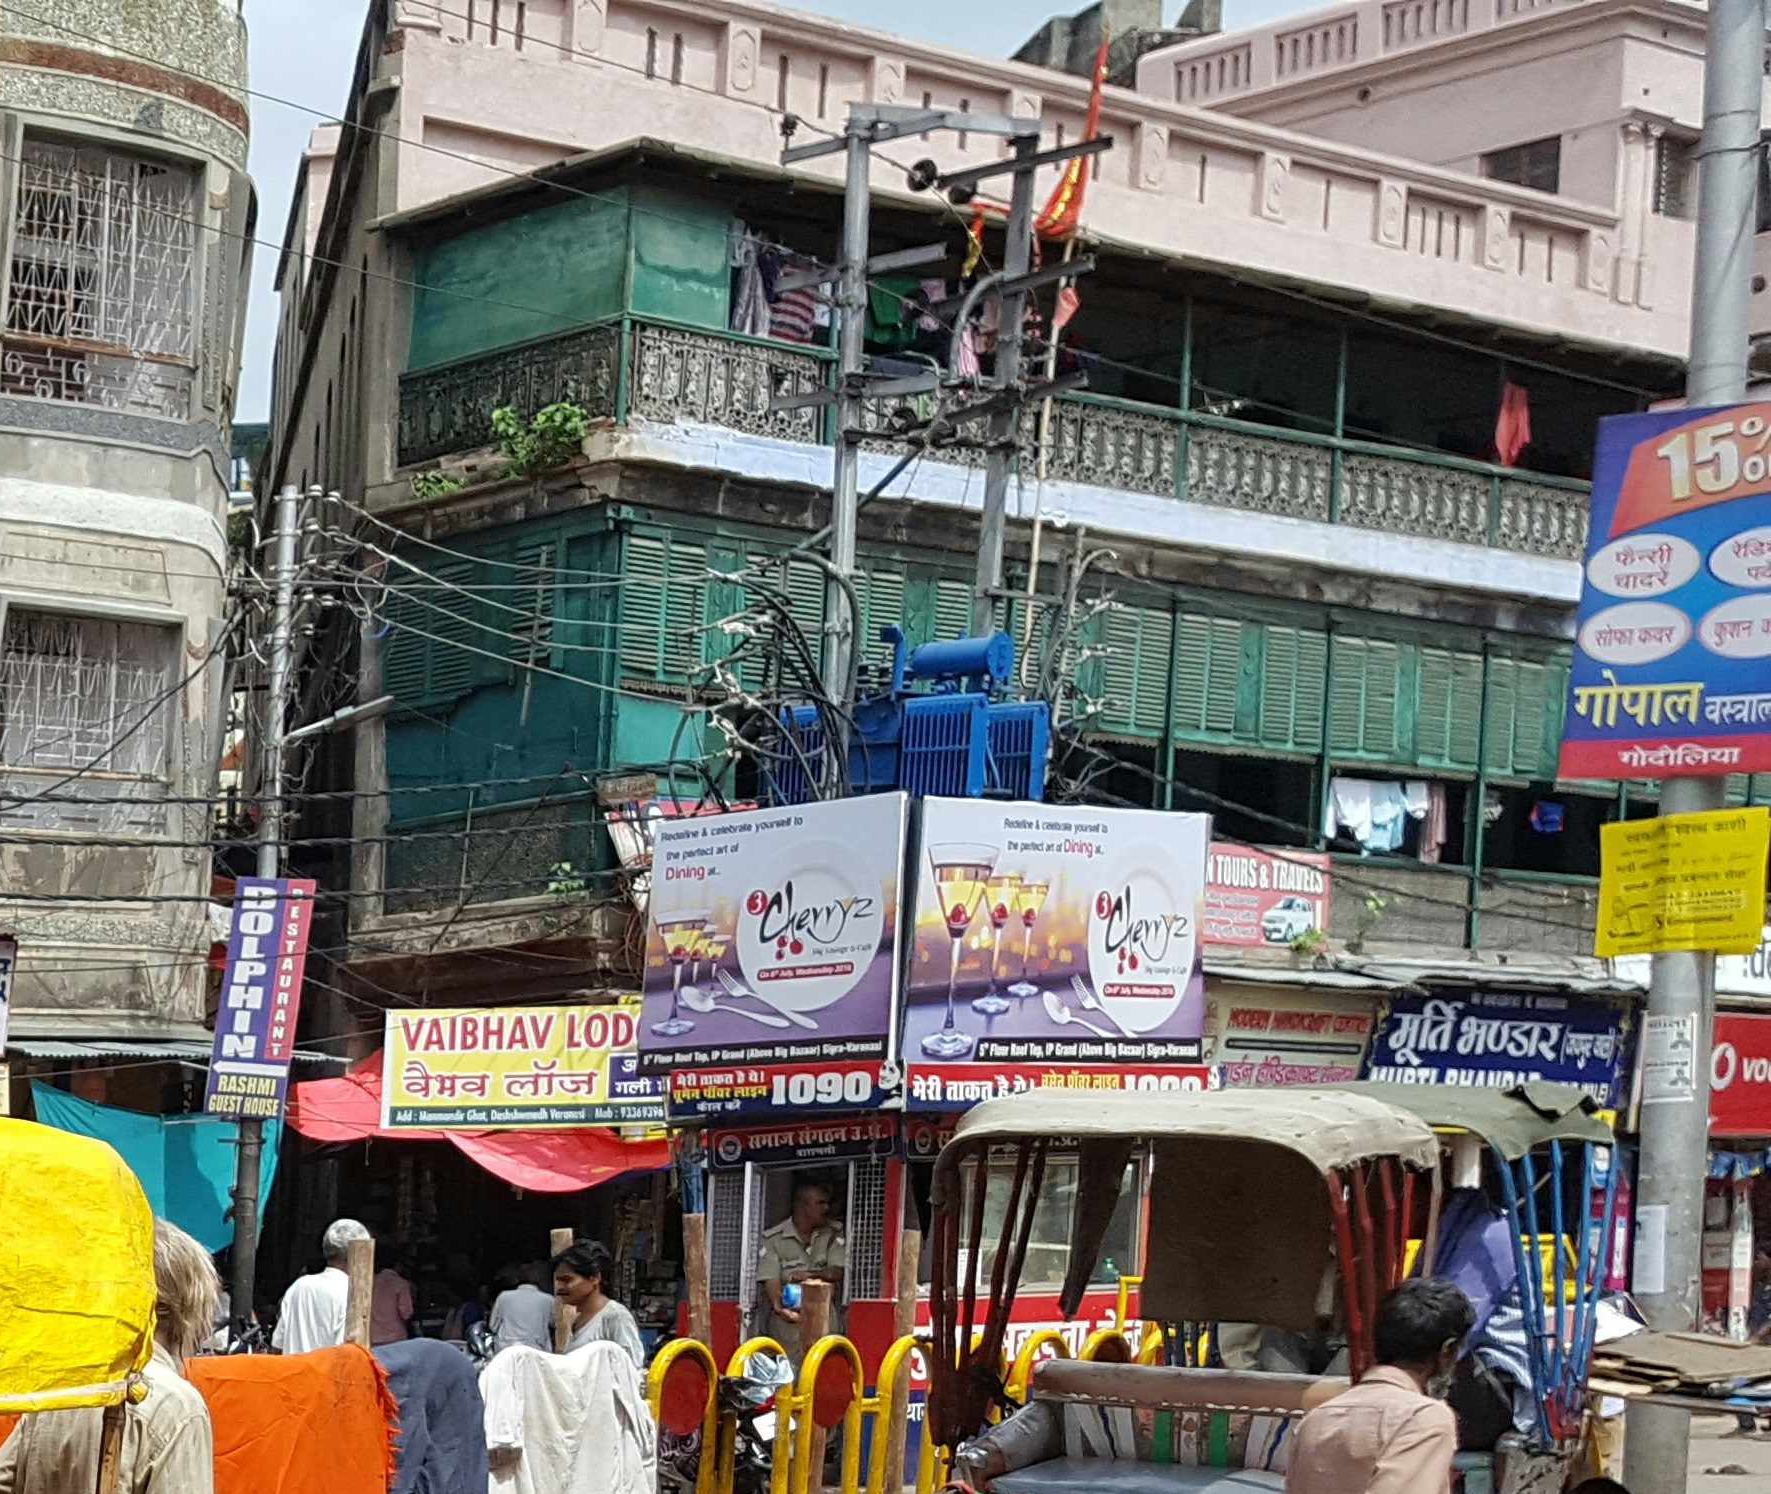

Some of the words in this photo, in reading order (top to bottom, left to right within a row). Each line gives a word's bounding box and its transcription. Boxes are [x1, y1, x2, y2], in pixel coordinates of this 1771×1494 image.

[1574, 668, 1705, 728] गोपाल
[710, 821, 752, 838] celebrate
[666, 849, 680, 861] the
[682, 846, 714, 864] perfect
[715, 845, 729, 856] art
[730, 843, 739, 854] of
[1063, 839, 1094, 858] Dining
[665, 866, 705, 882] Dining
[1216, 854, 1258, 889] TOURS
[1259, 864, 1270, 889] &
[221, 886, 278, 1058] DOLPHIN
[271, 888, 305, 1057] RESTAURANT
[400, 1014, 556, 1051] VAIBHAV
[567, 1013, 640, 1048] LOD
[1388, 1000, 1464, 1066] मूर्ति
[1456, 1016, 1563, 1062] भण्डार
[217, 1075, 277, 1096] RASHMI
[403, 1060, 491, 1098] वैभव
[504, 1059, 598, 1097] लॉज
[615, 1080, 652, 1096] गली
[676, 1071, 695, 1087] मेरी
[699, 1071, 734, 1087] ताकत
[771, 1071, 872, 1106] 1090
[912, 1074, 941, 1101] मेरी
[945, 1079, 992, 1101] ताकत
[993, 1074, 1010, 1098] है
[208, 1094, 243, 1115] GUEST
[244, 1096, 279, 1117] HOUSE
